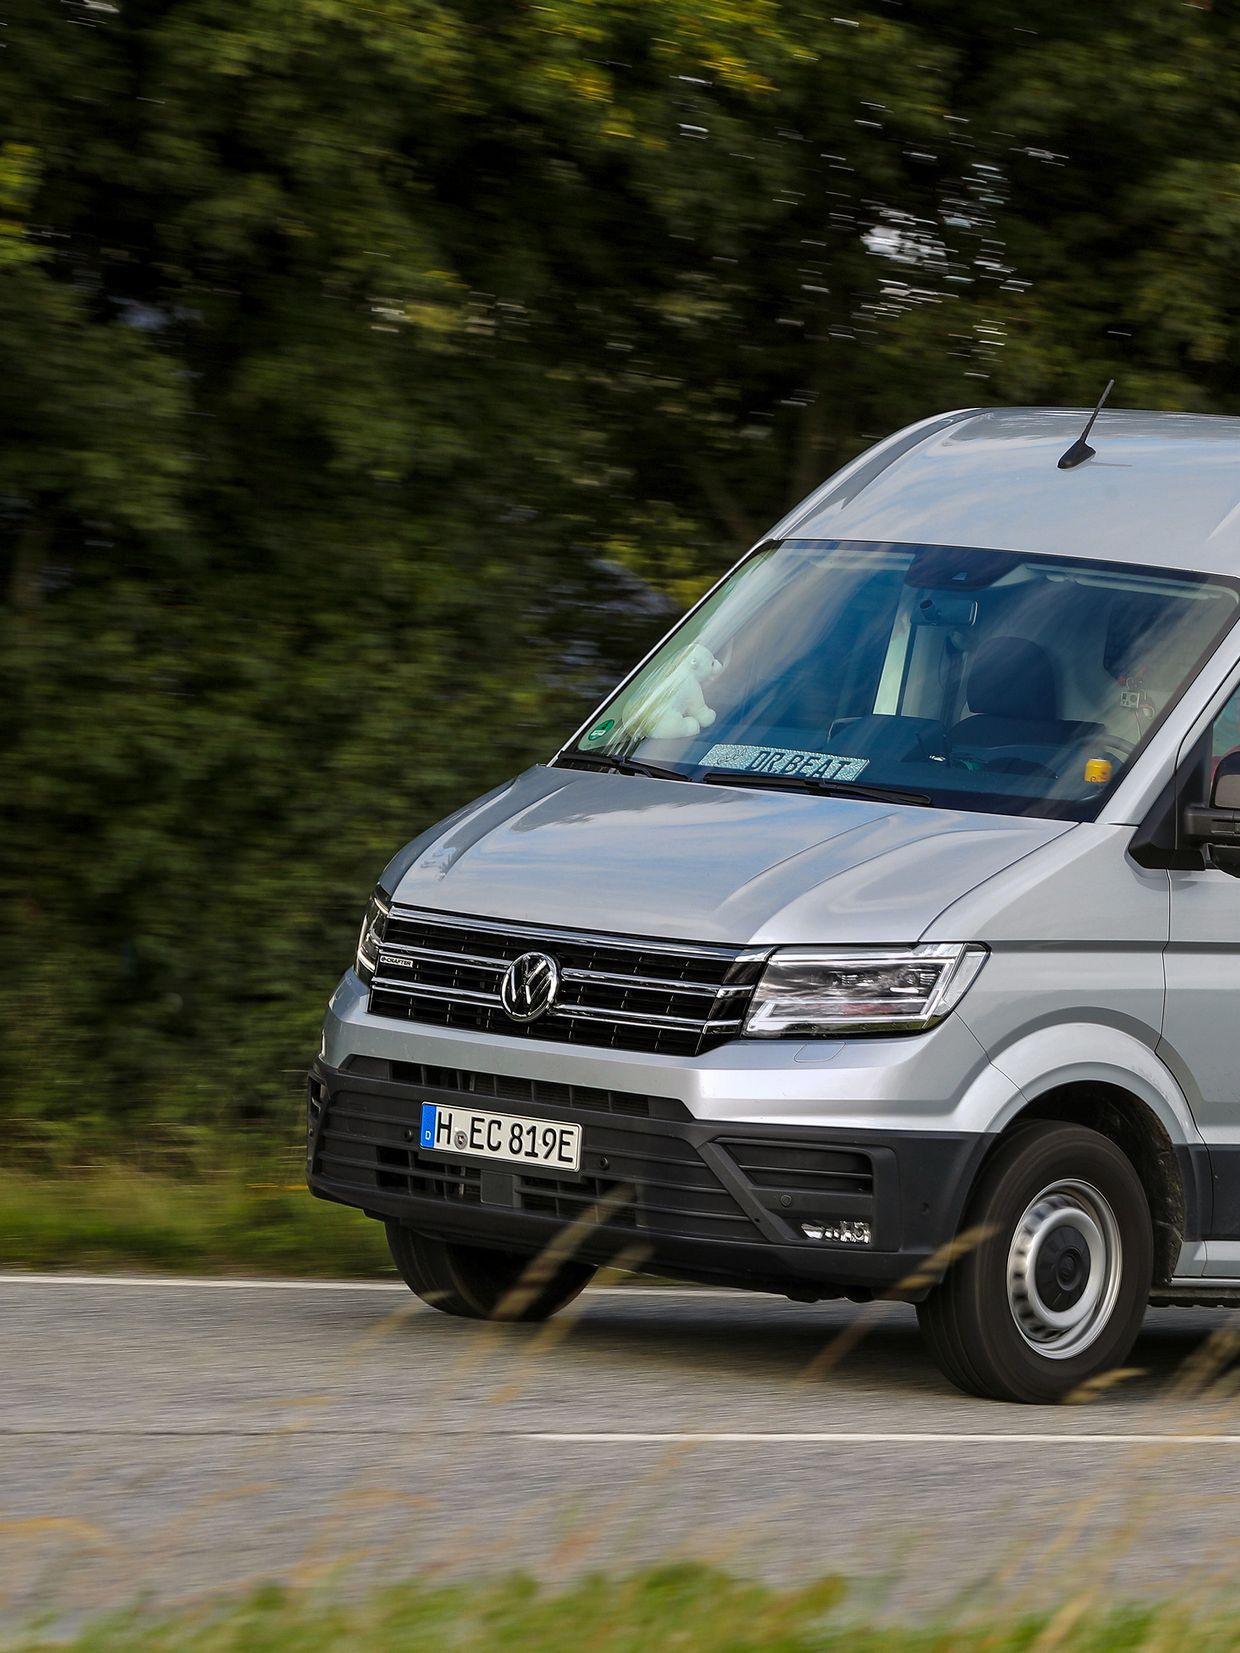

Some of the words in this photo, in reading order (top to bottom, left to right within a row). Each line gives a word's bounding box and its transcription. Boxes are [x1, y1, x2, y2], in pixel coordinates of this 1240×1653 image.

[424, 1130, 432, 1141] D
[436, 1111, 453, 1145] H
[469, 1116, 502, 1152] EC
[508, 1122, 575, 1163] 819E
